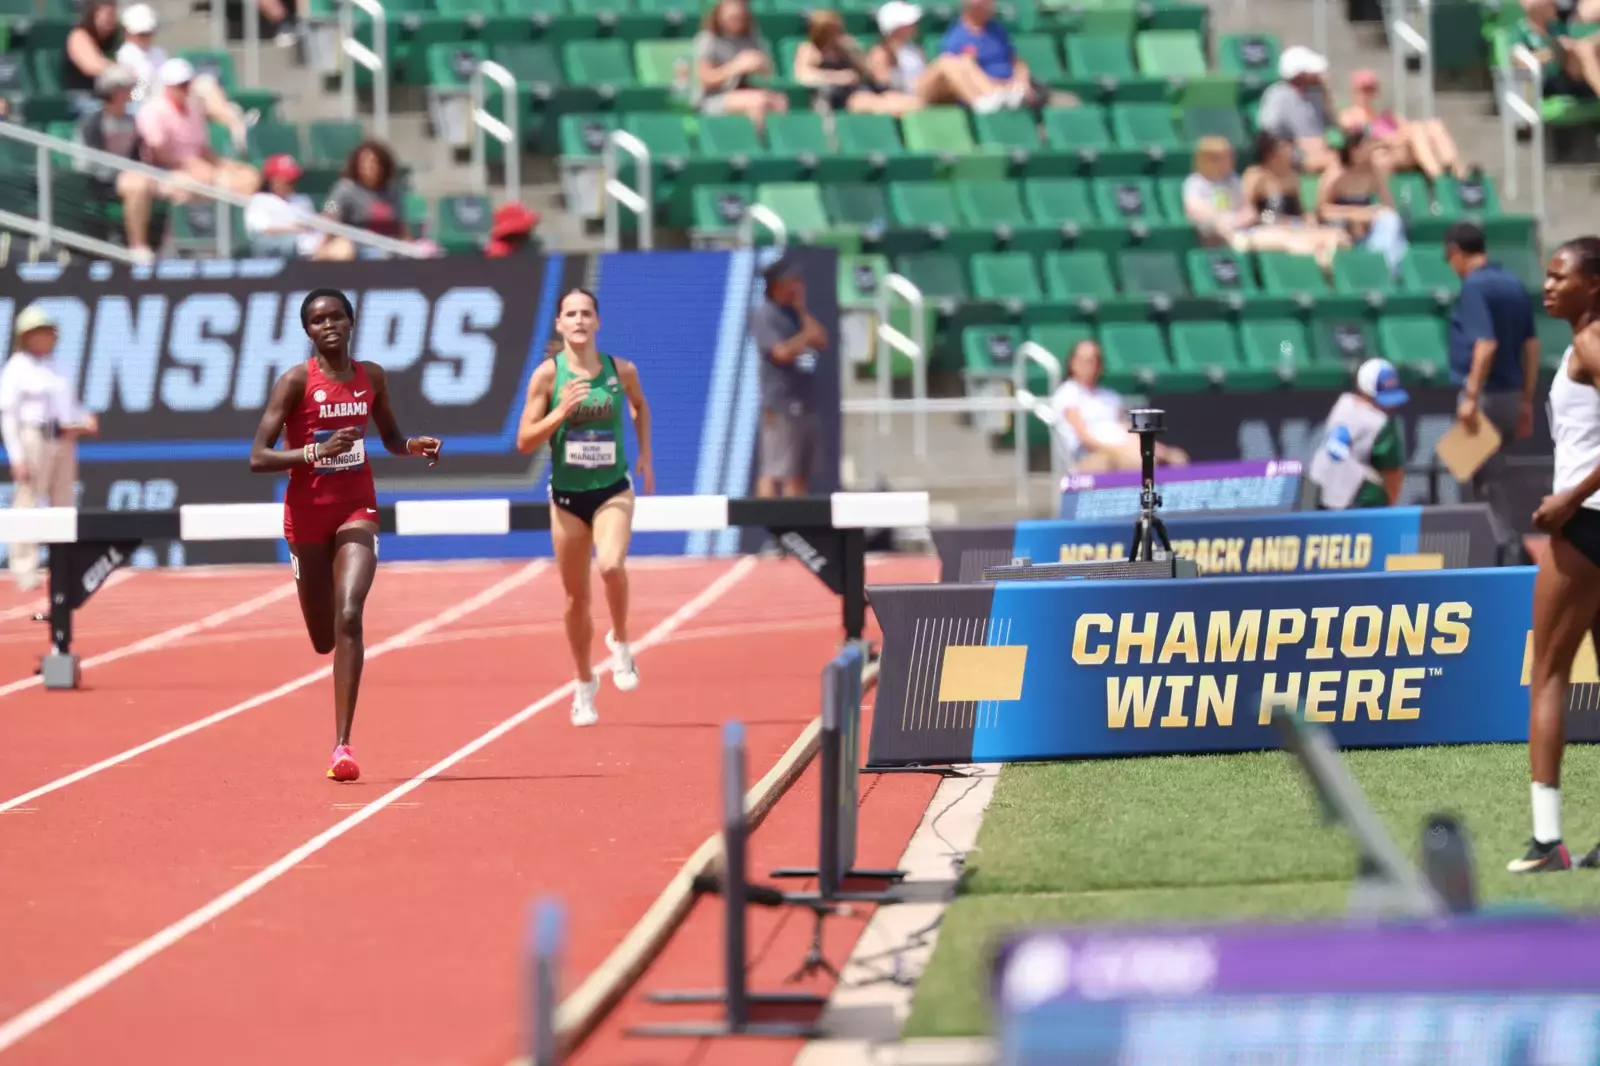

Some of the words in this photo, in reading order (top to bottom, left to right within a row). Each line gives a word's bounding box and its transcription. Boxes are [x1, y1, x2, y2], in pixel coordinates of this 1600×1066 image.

[319, 402, 367, 418] ALABAMA
[1246, 535, 1301, 571] AND
[1303, 533, 1373, 570] FIELD
[1071, 601, 1473, 665] CHAMPIONS
[1106, 674, 1239, 729] WIN
